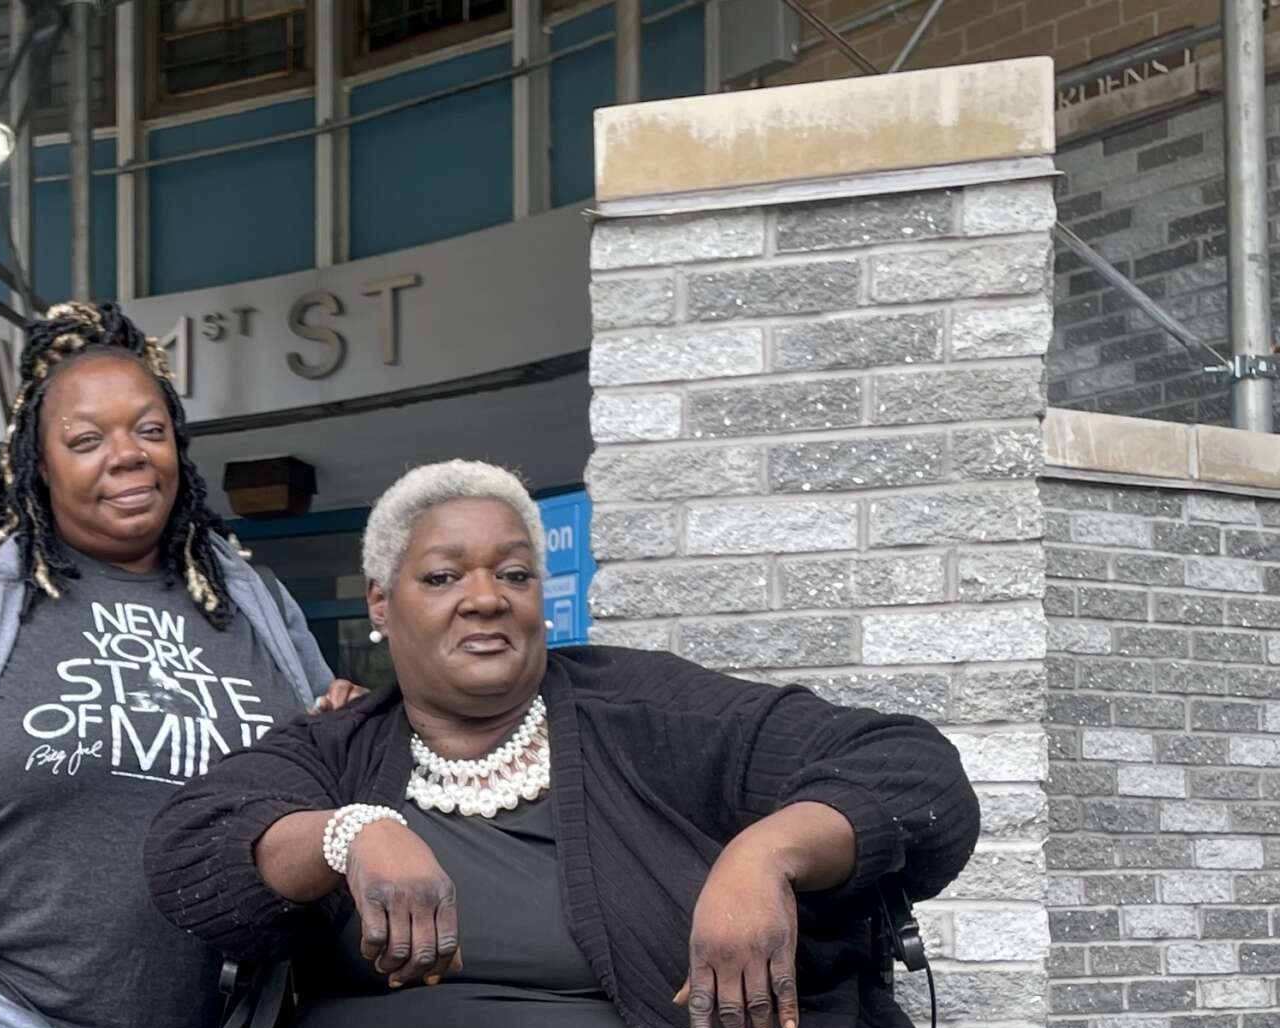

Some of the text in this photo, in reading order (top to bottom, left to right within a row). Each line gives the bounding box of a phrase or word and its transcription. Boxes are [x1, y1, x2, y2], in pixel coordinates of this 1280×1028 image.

[162, 305, 261, 398] 1ST
[286, 273, 423, 381] ST
[546, 525, 573, 552] on
[91, 602, 185, 643] NEW
[83, 631, 214, 674] YORK
[23, 703, 104, 738] OF
